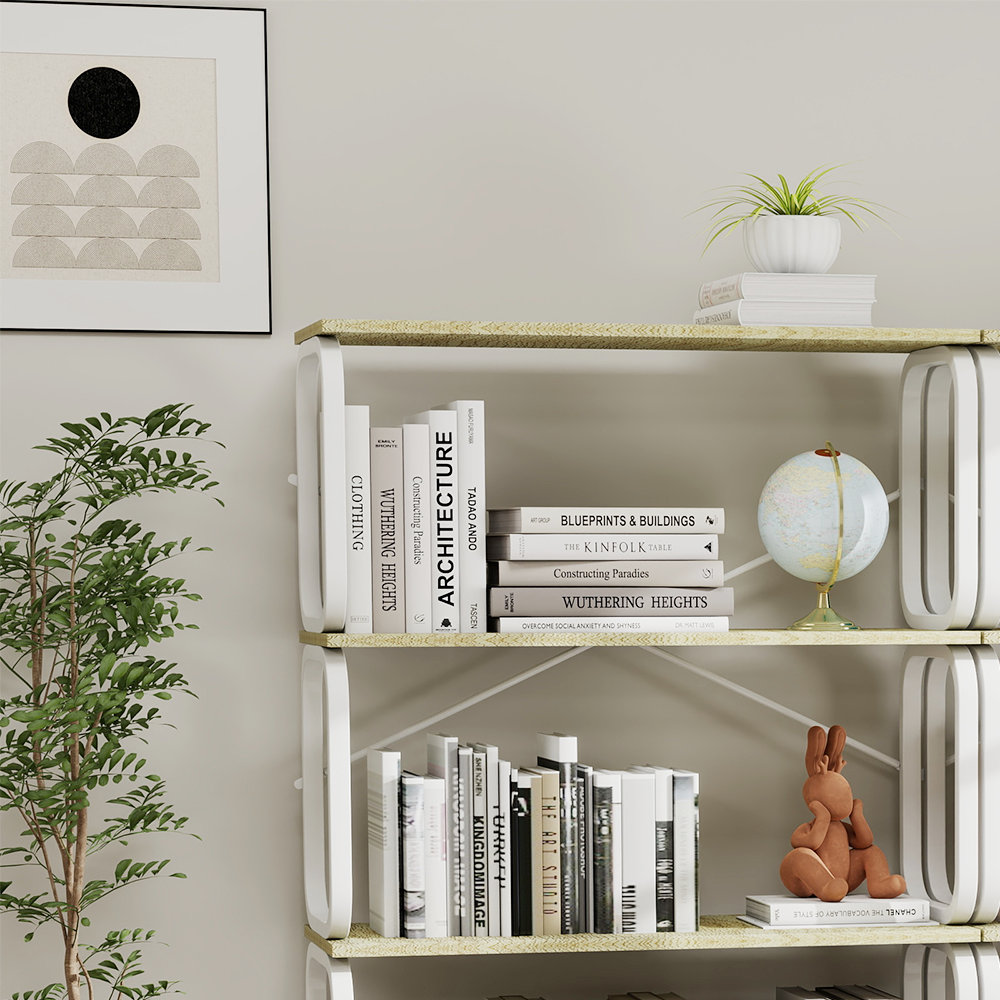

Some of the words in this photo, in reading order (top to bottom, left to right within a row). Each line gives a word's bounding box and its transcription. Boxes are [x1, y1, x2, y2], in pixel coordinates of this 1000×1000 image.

[351, 475, 364, 551] CLOTHING
[410, 476, 424, 529] Constructing
[467, 487, 477, 520] TADAO
[380, 488, 396, 558] WUTHERING
[435, 431, 455, 607] ARCHITECTURE
[561, 515, 626, 526] BLUEPRINTS
[629, 515, 637, 526] &
[640, 515, 695, 527] BUILDINGS
[413, 530, 424, 565] Paradies
[468, 523, 478, 551] ANDO
[564, 543, 580, 551] THE
[584, 541, 646, 553] KINFOLK
[648, 543, 672, 551] TABLE
[554, 568, 610, 581] Constructing
[612, 568, 650, 579] Paradies
[381, 563, 397, 612] HEIGHTS
[562, 596, 644, 609] WUTHERING
[651, 596, 708, 609] HEIGHTS
[541, 796, 557, 818] THE
[542, 831, 557, 854] ART
[542, 865, 558, 915] STUDIO
[793, 910, 814, 918] STYLE
[815, 910, 825, 918] OF
[826, 909, 870, 917] VOCABULARY
[885, 908, 917, 916] CHANEL
